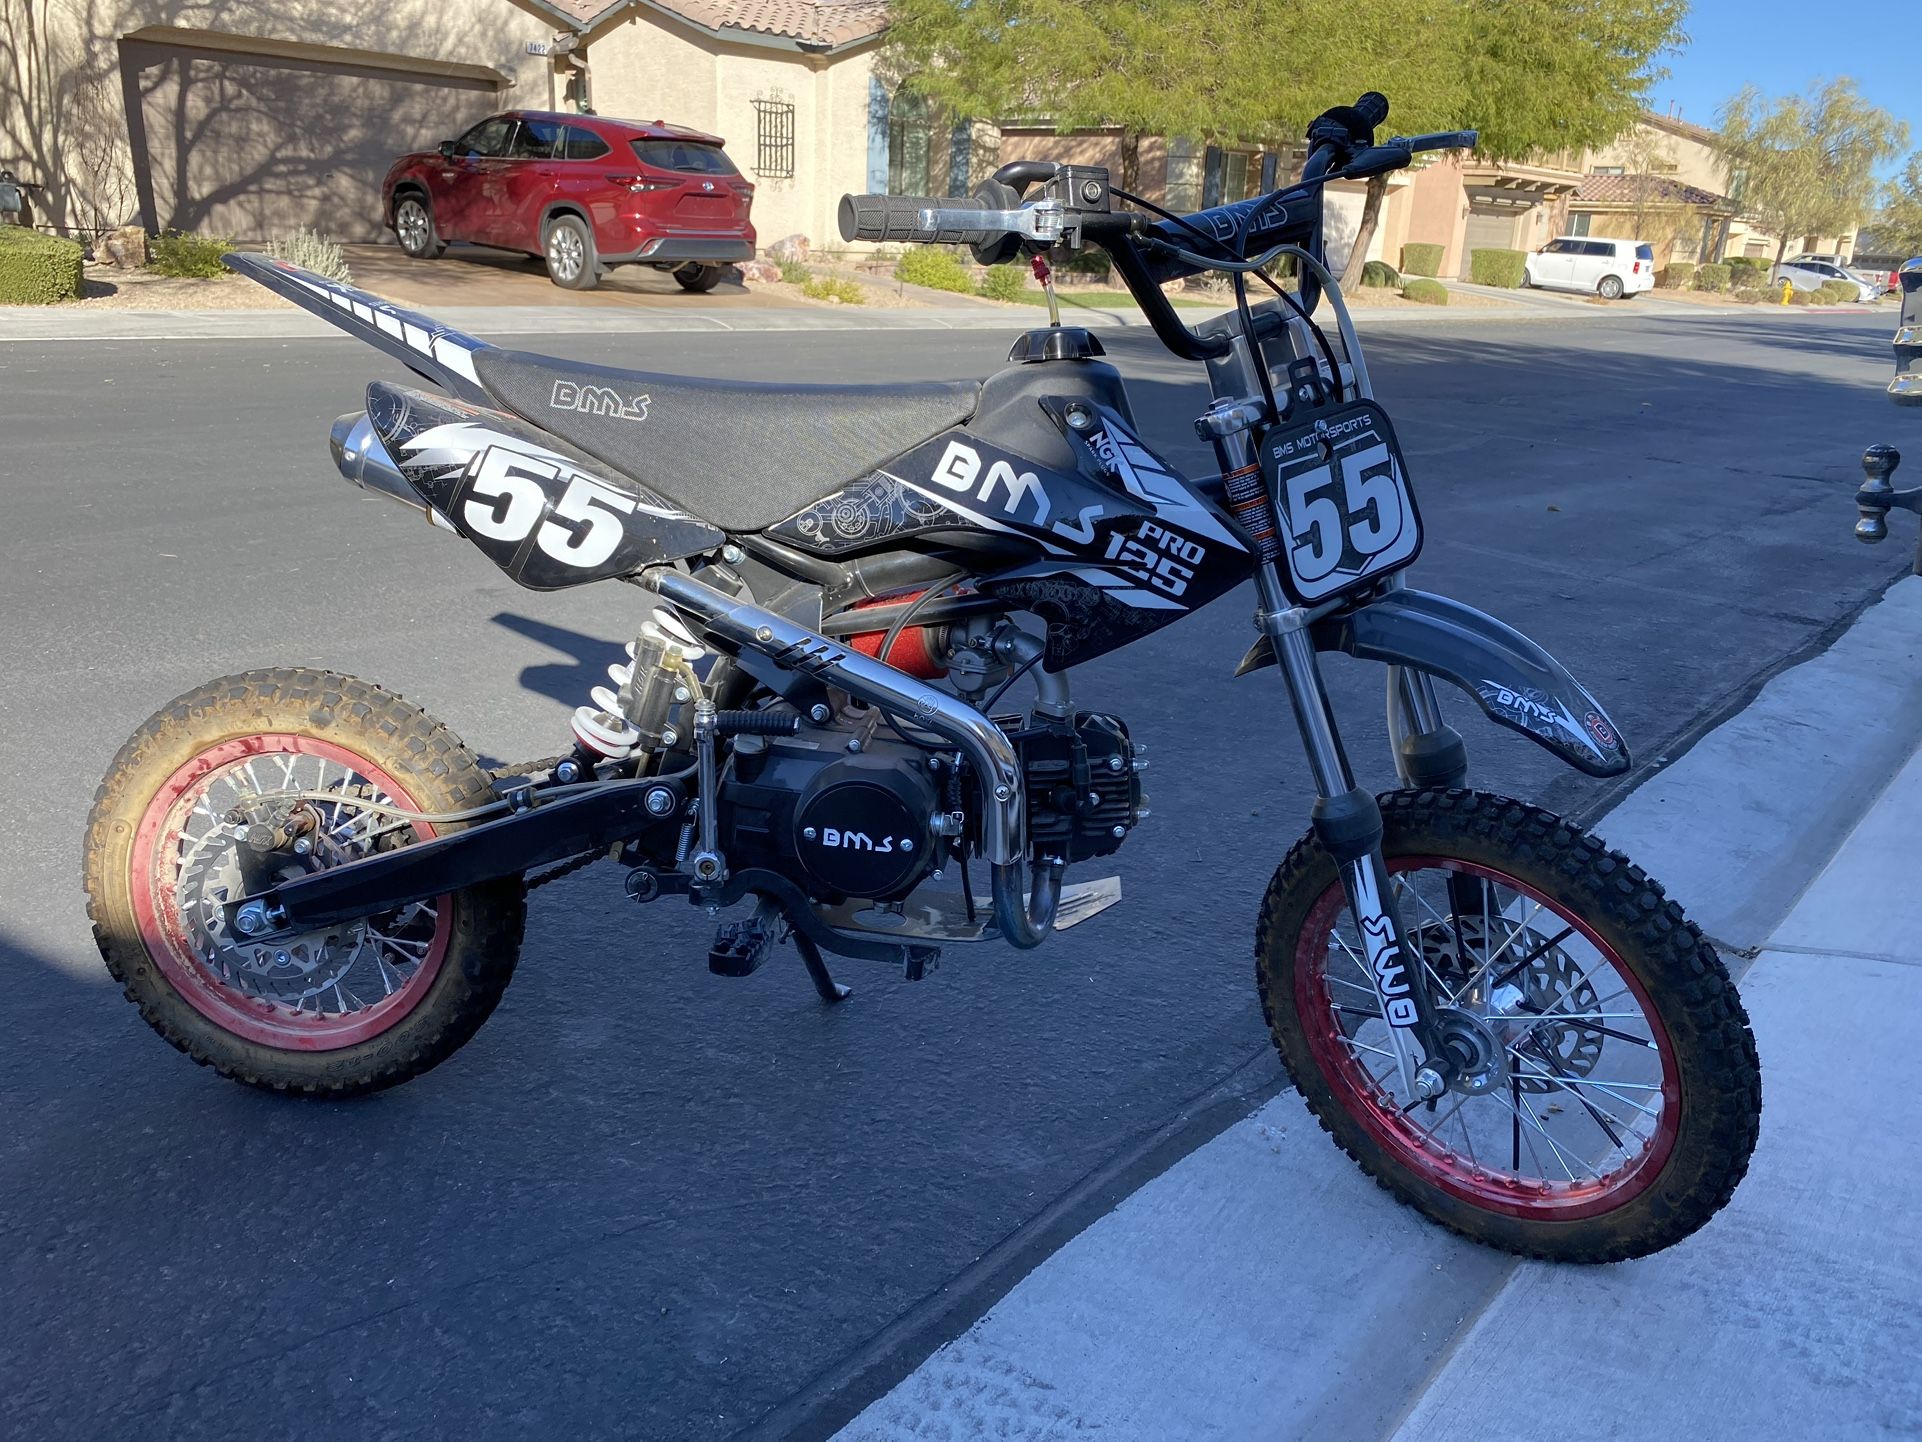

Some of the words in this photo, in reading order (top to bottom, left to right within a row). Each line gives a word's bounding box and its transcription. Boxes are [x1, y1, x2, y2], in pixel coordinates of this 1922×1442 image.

[550, 379, 652, 422] BMS
[1089, 430, 1123, 473] NGK
[1273, 441, 1295, 459] BMS
[464, 445, 636, 568] 55
[931, 440, 1104, 545] BMS
[1286, 442, 1401, 580] 55
[1104, 530, 1195, 597] 125
[1137, 520, 1206, 566] PRO
[1496, 689, 1557, 723] BMS
[822, 828, 893, 852] BMS
[1360, 915, 1420, 1026] BMS
